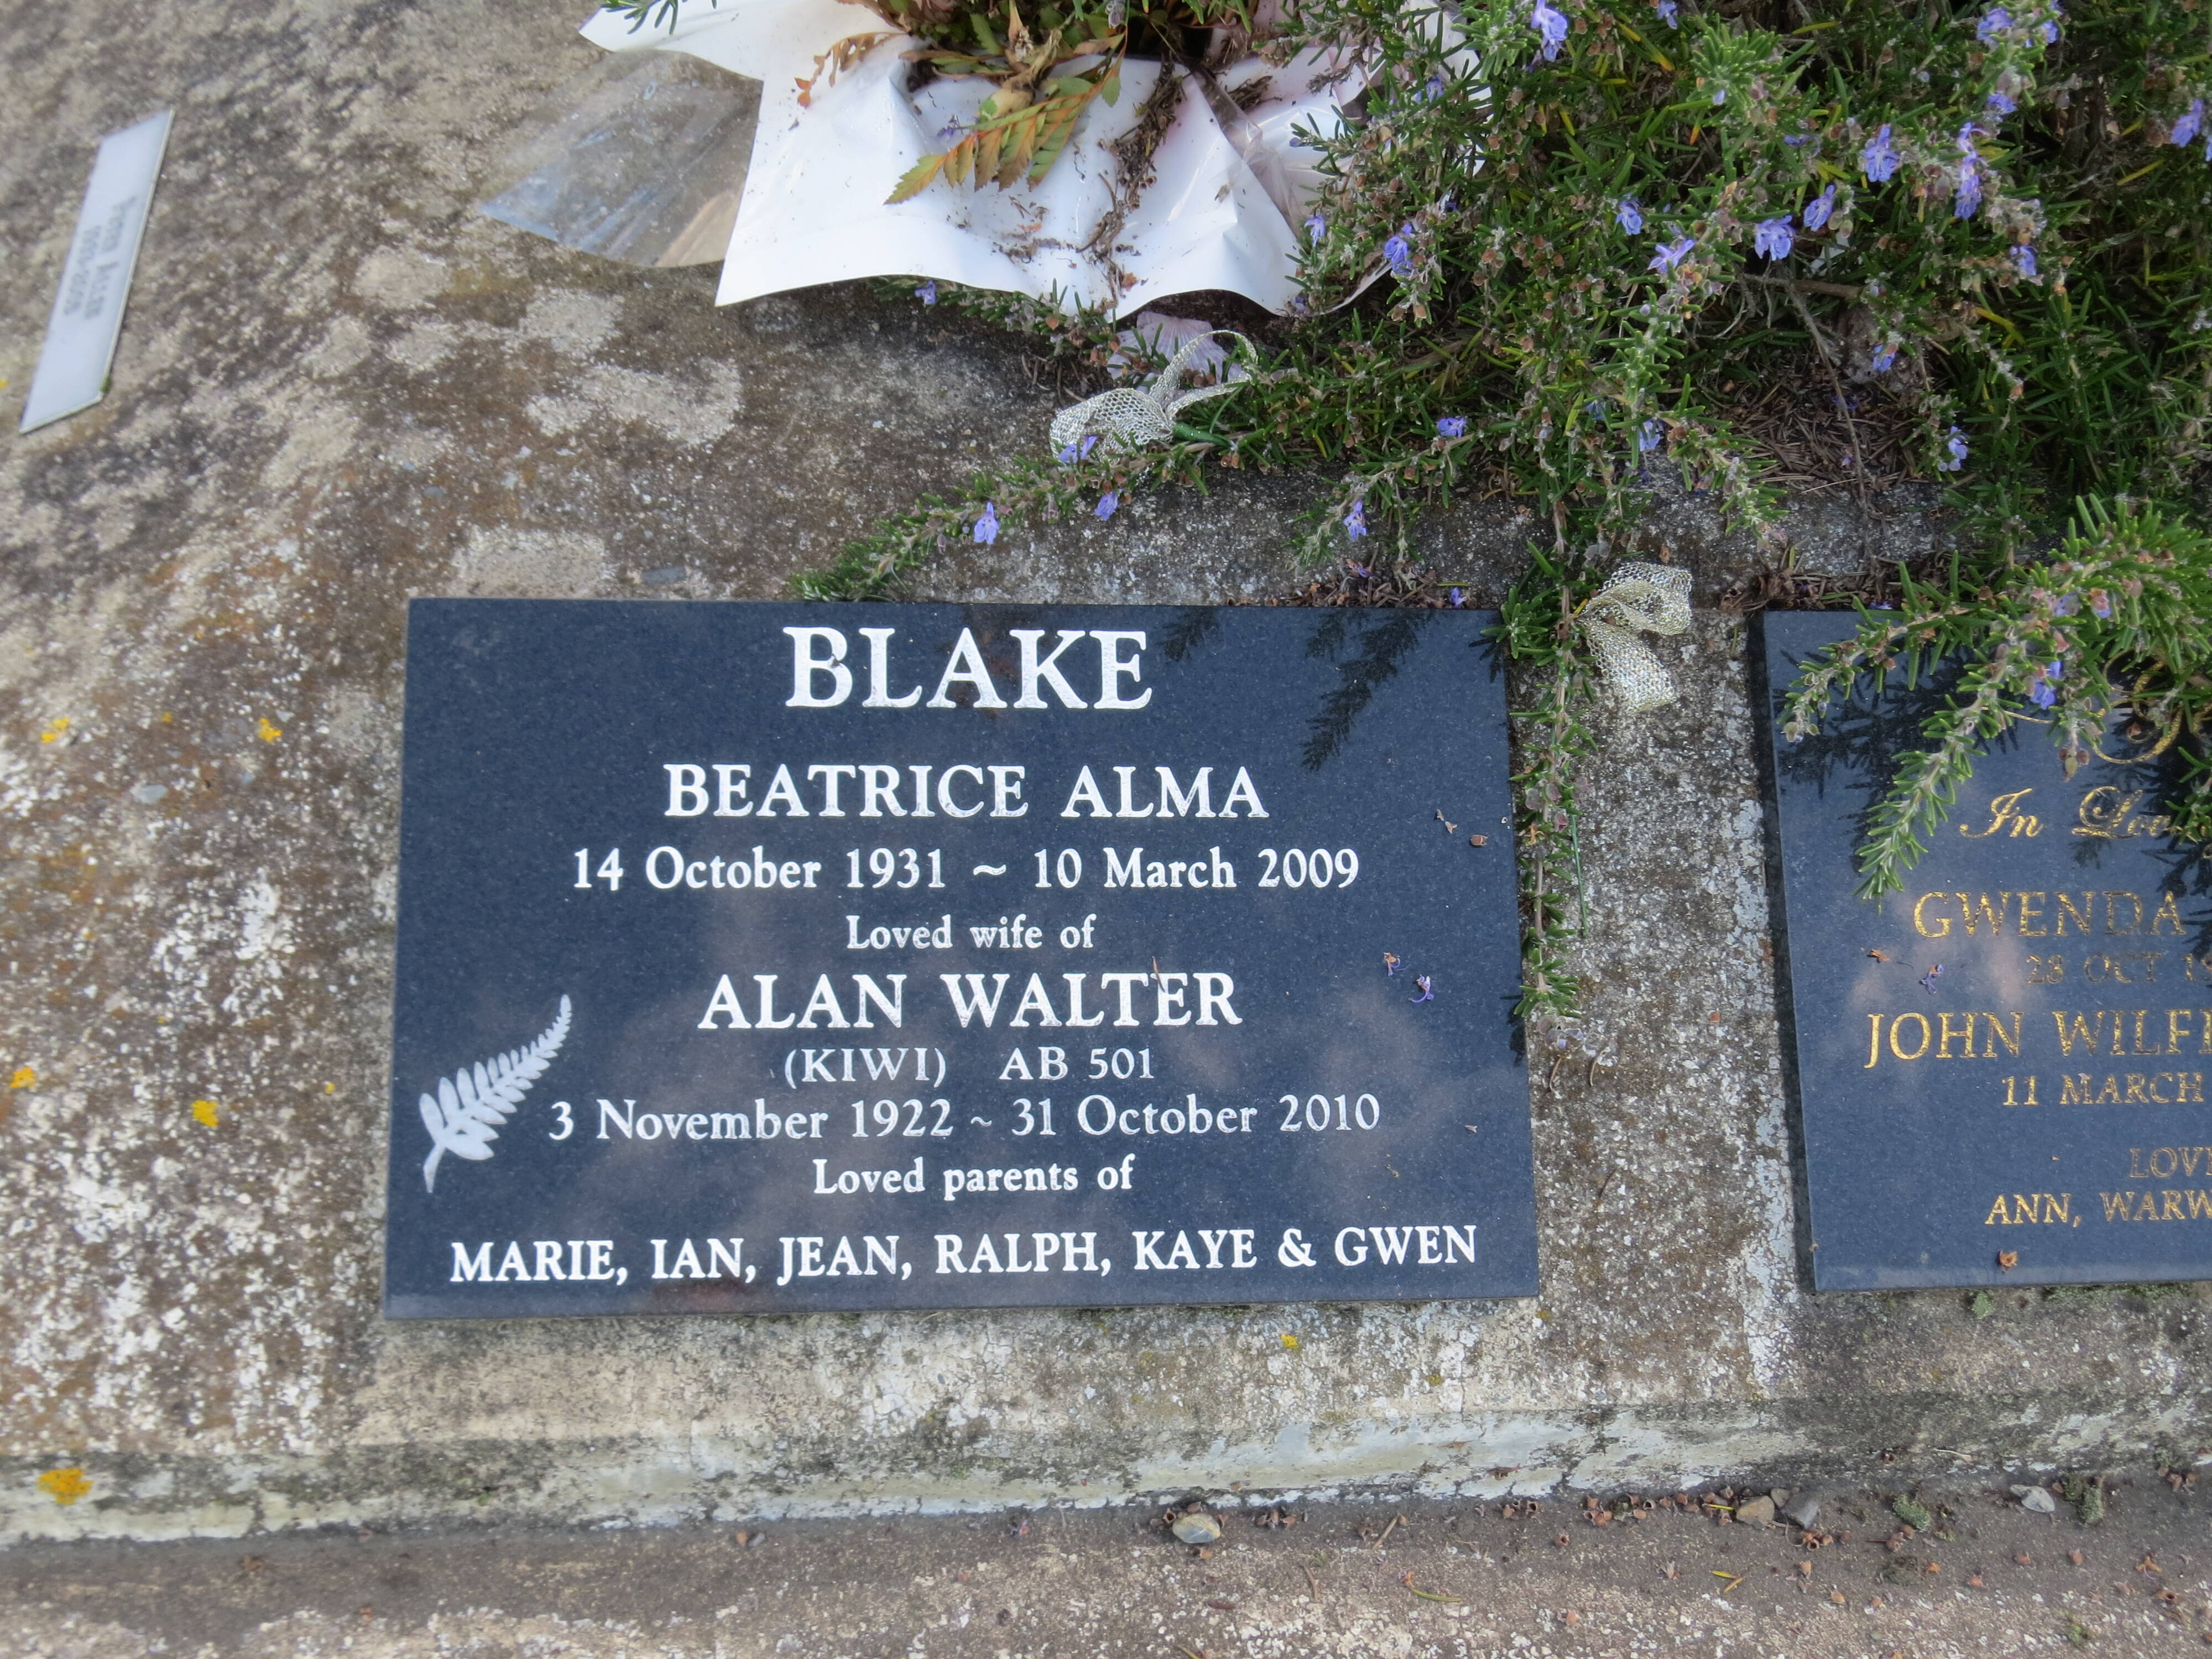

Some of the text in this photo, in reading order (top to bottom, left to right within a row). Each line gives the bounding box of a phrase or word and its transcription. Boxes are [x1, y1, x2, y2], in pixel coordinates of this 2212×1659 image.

[783, 627, 1152, 710] BLAKE
[663, 764, 1270, 818] BEATRICE ALMA
[1960, 787, 2044, 838] In
[573, 847, 624, 891] 14
[645, 846, 822, 889] October
[846, 848, 946, 889] 1931
[1034, 848, 1082, 889] 10
[1103, 846, 1237, 888] March
[1258, 848, 1359, 888] 2009
[846, 913, 1097, 950] Loved wife of
[1913, 891, 2187, 938] GWENDA
[2027, 954, 2063, 984] 28
[2084, 952, 2163, 984] OCT
[697, 972, 1243, 1030] ALAN WALTER
[1863, 1011, 2025, 1068] JOHN
[785, 1046, 1155, 1089] (KIWI) AB 501
[2001, 1072, 2204, 1106] 11 MARCH
[549, 1101, 574, 1140] 3
[596, 1098, 829, 1140] November
[851, 1098, 953, 1138] 1922
[1011, 1098, 1056, 1136] 31
[1077, 1093, 1258, 1136] October
[1279, 1093, 1380, 1132] 2010
[812, 1153, 1136, 1202] Loved parents of
[2129, 1146, 2212, 1178] LOV
[1985, 1192, 2081, 1228] ANN,
[450, 1224, 1477, 1286] MARIE, IAN, JEAN, RALPH, KAYE & GWEN
